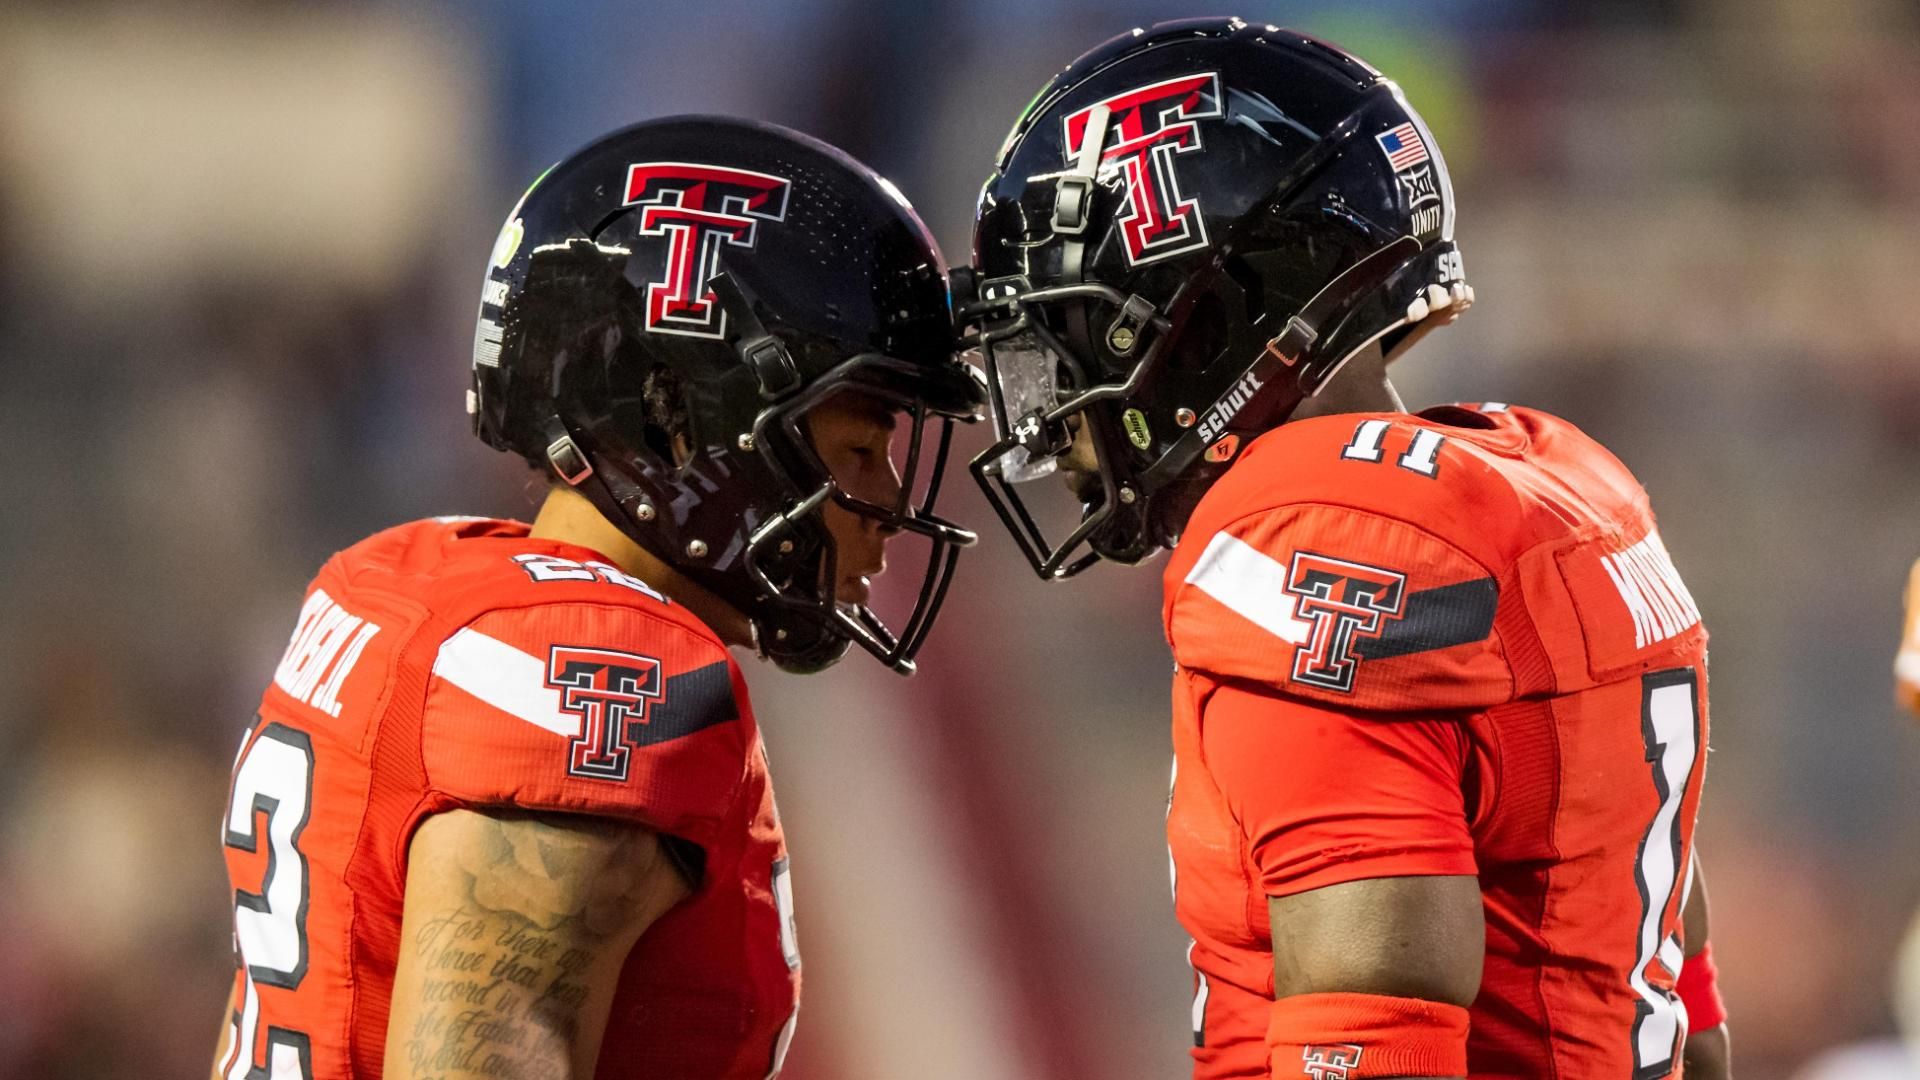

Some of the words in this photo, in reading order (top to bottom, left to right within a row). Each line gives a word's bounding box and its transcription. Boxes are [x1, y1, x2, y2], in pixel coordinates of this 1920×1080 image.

[1411, 204, 1441, 237] UNITY
[1197, 371, 1264, 444] schutt
[1340, 419, 1446, 480] 11
